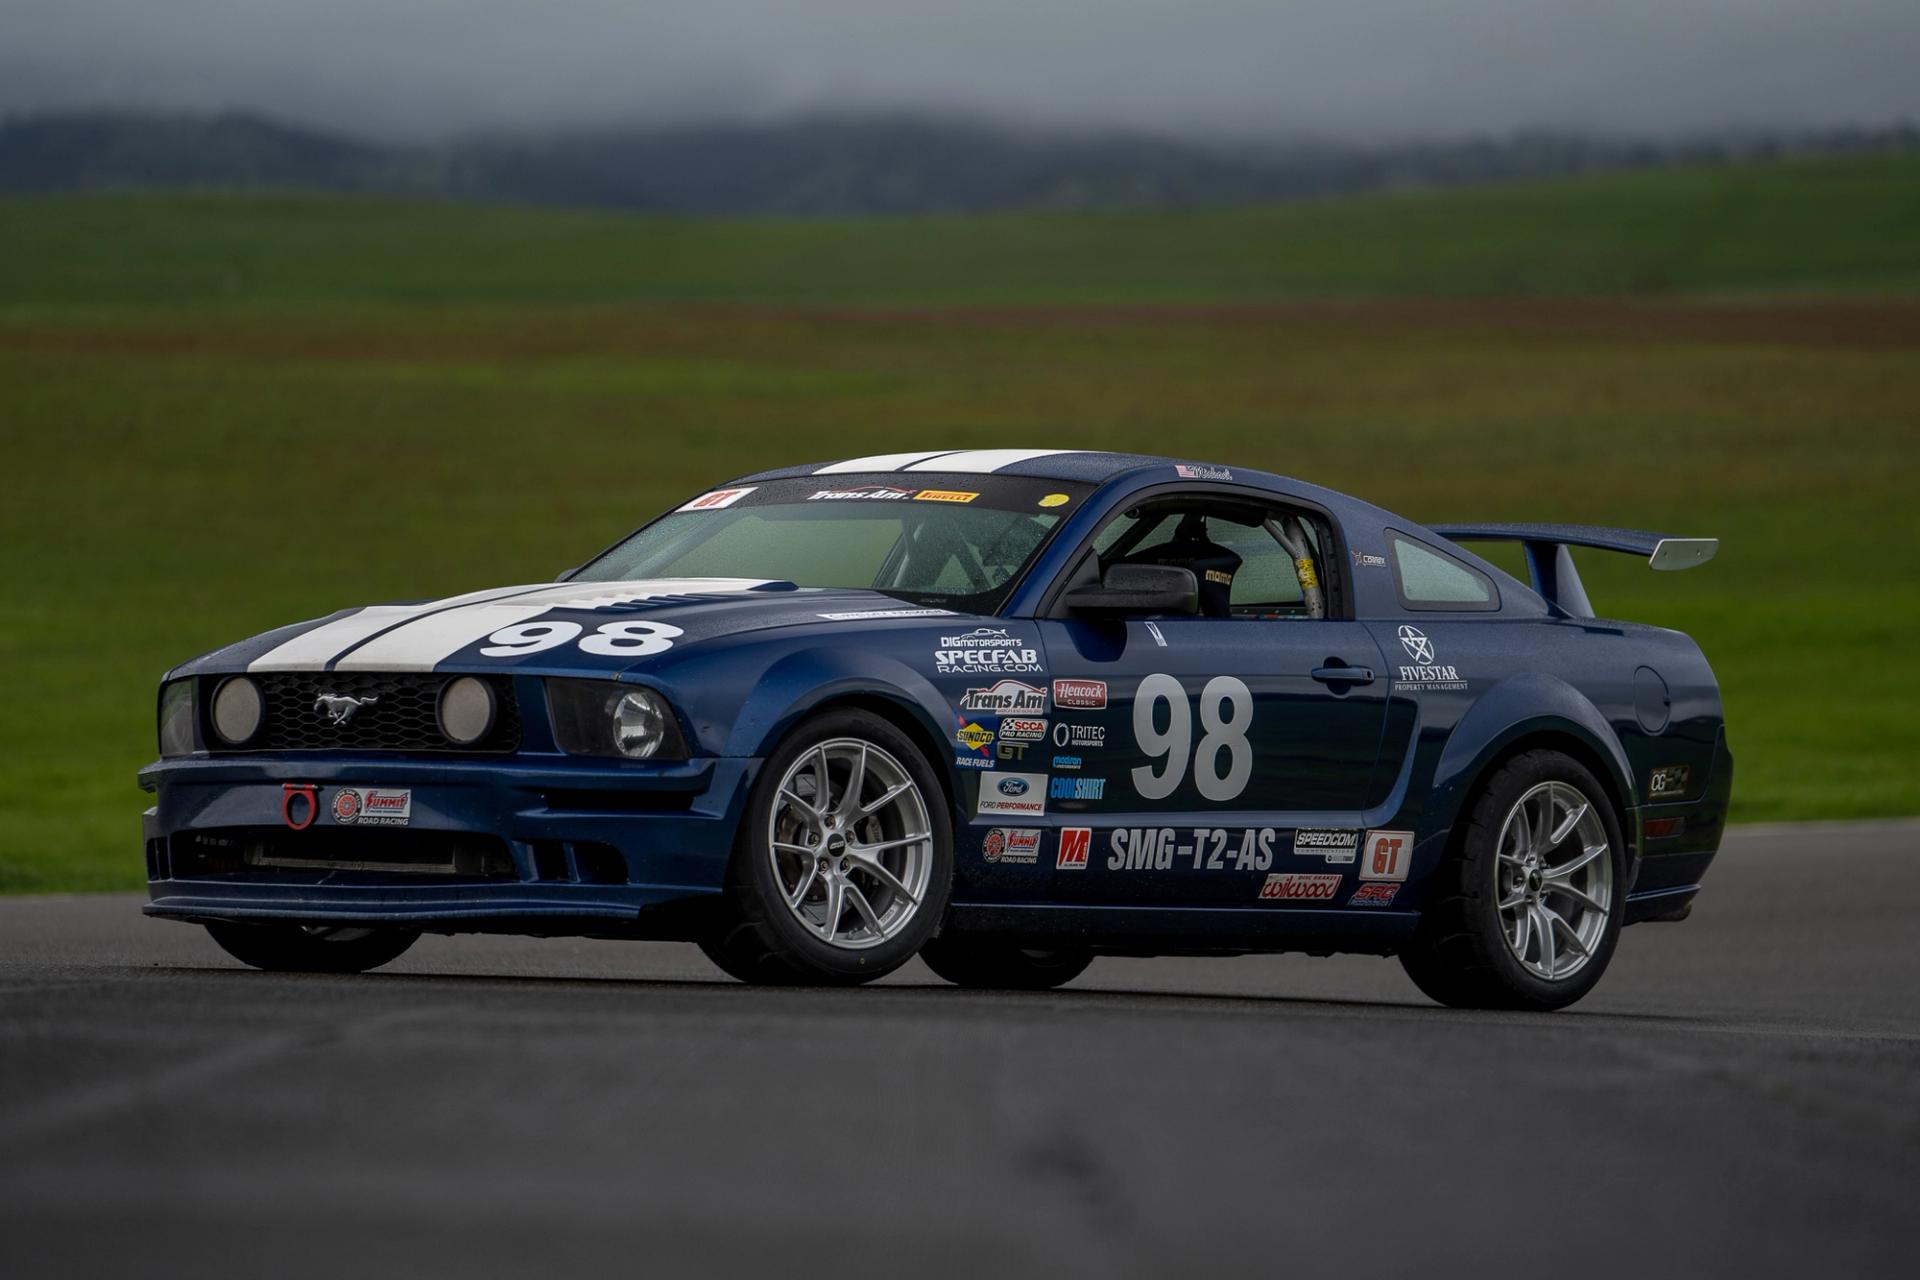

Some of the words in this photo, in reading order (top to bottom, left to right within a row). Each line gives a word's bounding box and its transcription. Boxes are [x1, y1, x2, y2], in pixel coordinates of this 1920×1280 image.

[921, 491, 972, 501] PIRELLI
[479, 620, 685, 657] 98
[934, 649, 1038, 665] SPECFAB
[937, 664, 1043, 673] RACING.COM
[1399, 666, 1460, 681] FIVESTAR
[1057, 683, 1104, 698] Heacock
[1427, 683, 1469, 691] MANAGEMENT
[967, 689, 1012, 709] Trans
[1013, 689, 1043, 709] Am
[1014, 721, 1044, 731] SCCA
[1070, 725, 1106, 740] TRITEC
[958, 730, 993, 745] SUNOCO
[1016, 731, 1043, 739] RACING
[1131, 673, 1254, 802] 98
[956, 757, 972, 766] RACE
[972, 758, 996, 768] FUELS
[1003, 780, 1025, 793] Ford
[980, 801, 996, 809] FORD
[996, 802, 1043, 811] PERFORMANCE
[357, 817, 379, 825] ROAD
[380, 817, 409, 826] RACING
[1296, 832, 1356, 846] SPEEDCOM
[1107, 828, 1276, 871] SMG-T2-AS
[1372, 838, 1402, 874] GT
[1000, 856, 1017, 864] ROAD
[1017, 856, 1038, 864] RACING
